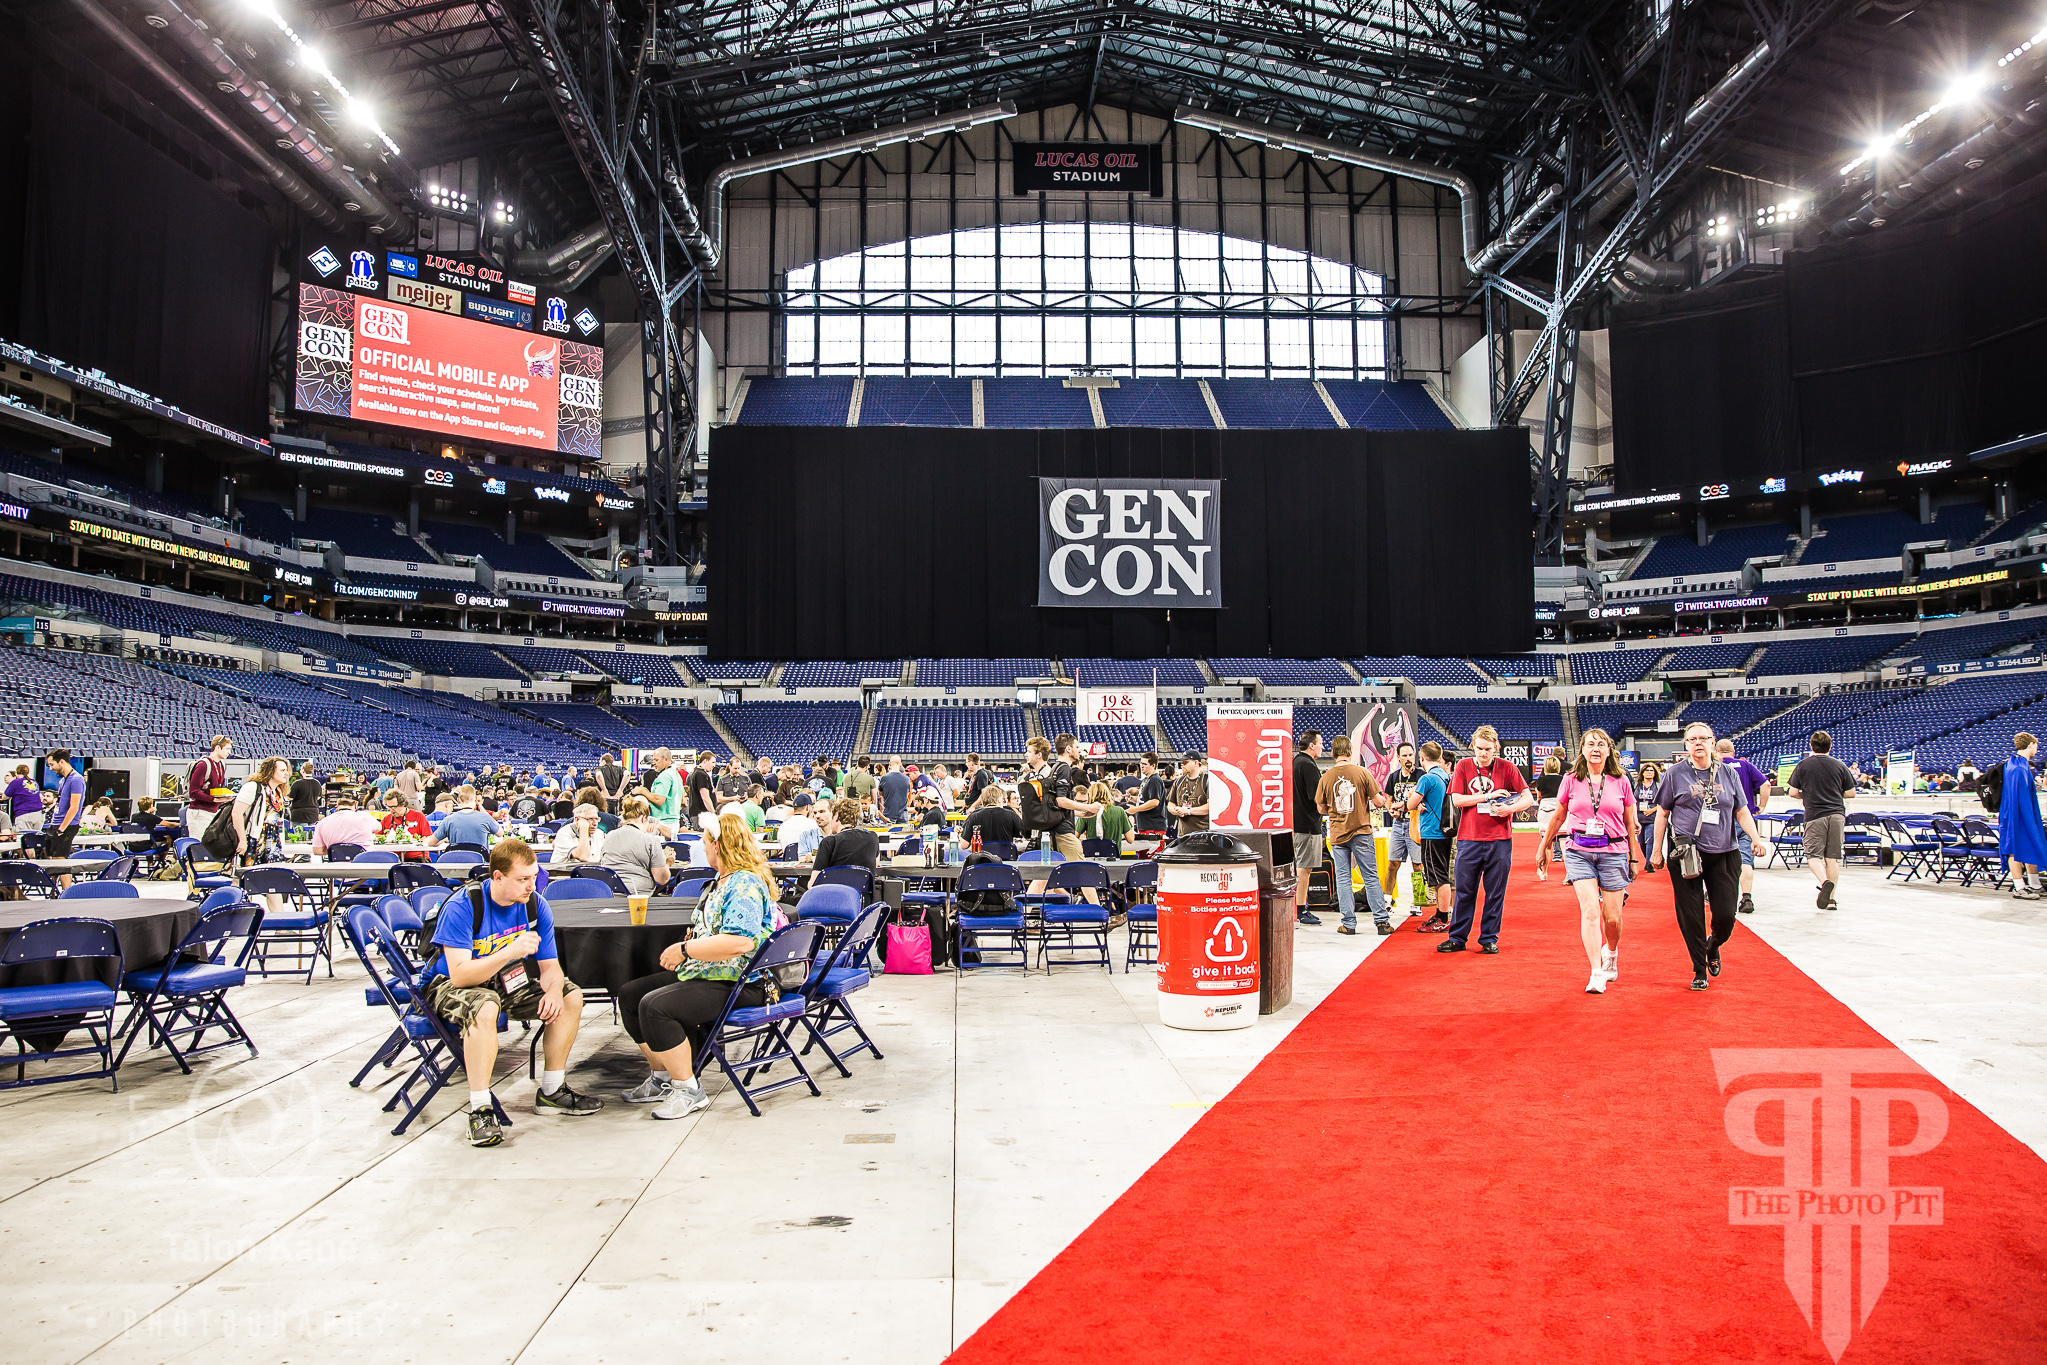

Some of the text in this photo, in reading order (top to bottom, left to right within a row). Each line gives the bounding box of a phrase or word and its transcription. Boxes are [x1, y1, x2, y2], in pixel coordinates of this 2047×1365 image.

[1034, 152, 1139, 168] LUCAS OIL
[1053, 171, 1121, 182] STADIUM
[425, 254, 475, 277] LUCAS
[478, 267, 504, 284] OIL
[346, 275, 379, 290] paizo
[438, 272, 491, 293] STADIUM
[396, 283, 453, 307] meijer
[365, 308, 404, 326] GEN
[468, 301, 488, 312] BUD
[488, 305, 515, 319] LIGHT
[364, 321, 403, 340] CON
[543, 320, 571, 333] paizo
[305, 326, 346, 345] GEN
[304, 340, 346, 359] CON
[359, 346, 529, 393] OFFICIAL MOBILE APP
[75, 374, 153, 410] JEFF SATURDAY 1999-11
[359, 369, 540, 412] Find events, check your schedule, buy tickets,
[563, 377, 596, 394] GEN
[358, 382, 500, 414] search interactive maps, and more!
[563, 390, 596, 406] CON
[187, 416, 201, 429] BILL
[201, 422, 223, 436] POLIAN
[357, 397, 547, 439] Available now on the App Store and Google Play.
[280, 452, 405, 477] GEN CON CONTRIBUTING SPONSORS
[1909, 459, 1952, 472] MAGIC
[603, 498, 635, 509] MAGIC
[1574, 493, 1681, 512] GEN CON CONTRIBUTING SPONSORS
[1050, 488, 1211, 541] GEN
[70, 520, 250, 572] STAY UP TO DATE WITH GEN CON NEWS ON SOCIAL MEDIA!
[1807, 570, 2009, 602] STAY UP TO DATE WITH GEN CON NEWS ON SOCIAL MEDIA!
[468, 595, 509, 608] @GEN_CON
[1684, 597, 1769, 611] TWITCH.TV/GENCONTV
[552, 603, 625, 617] TWITCH.TV/GENCONTV
[654, 611, 691, 621] STAY UP TO
[1601, 606, 1641, 618] @GEN_CON
[36, 621, 49, 630] 115
[160, 636, 171, 645] 116
[335, 662, 354, 674] TEXT
[1937, 663, 1961, 673] TEXT
[1101, 694, 1134, 708] 19 &
[1097, 710, 1135, 722] ONE
[1217, 707, 1283, 716] heroscapers.com
[1504, 746, 1528, 756] GEN
[1192, 962, 1256, 978] give it back
[1214, 1004, 1242, 1013] REPUBLIC
